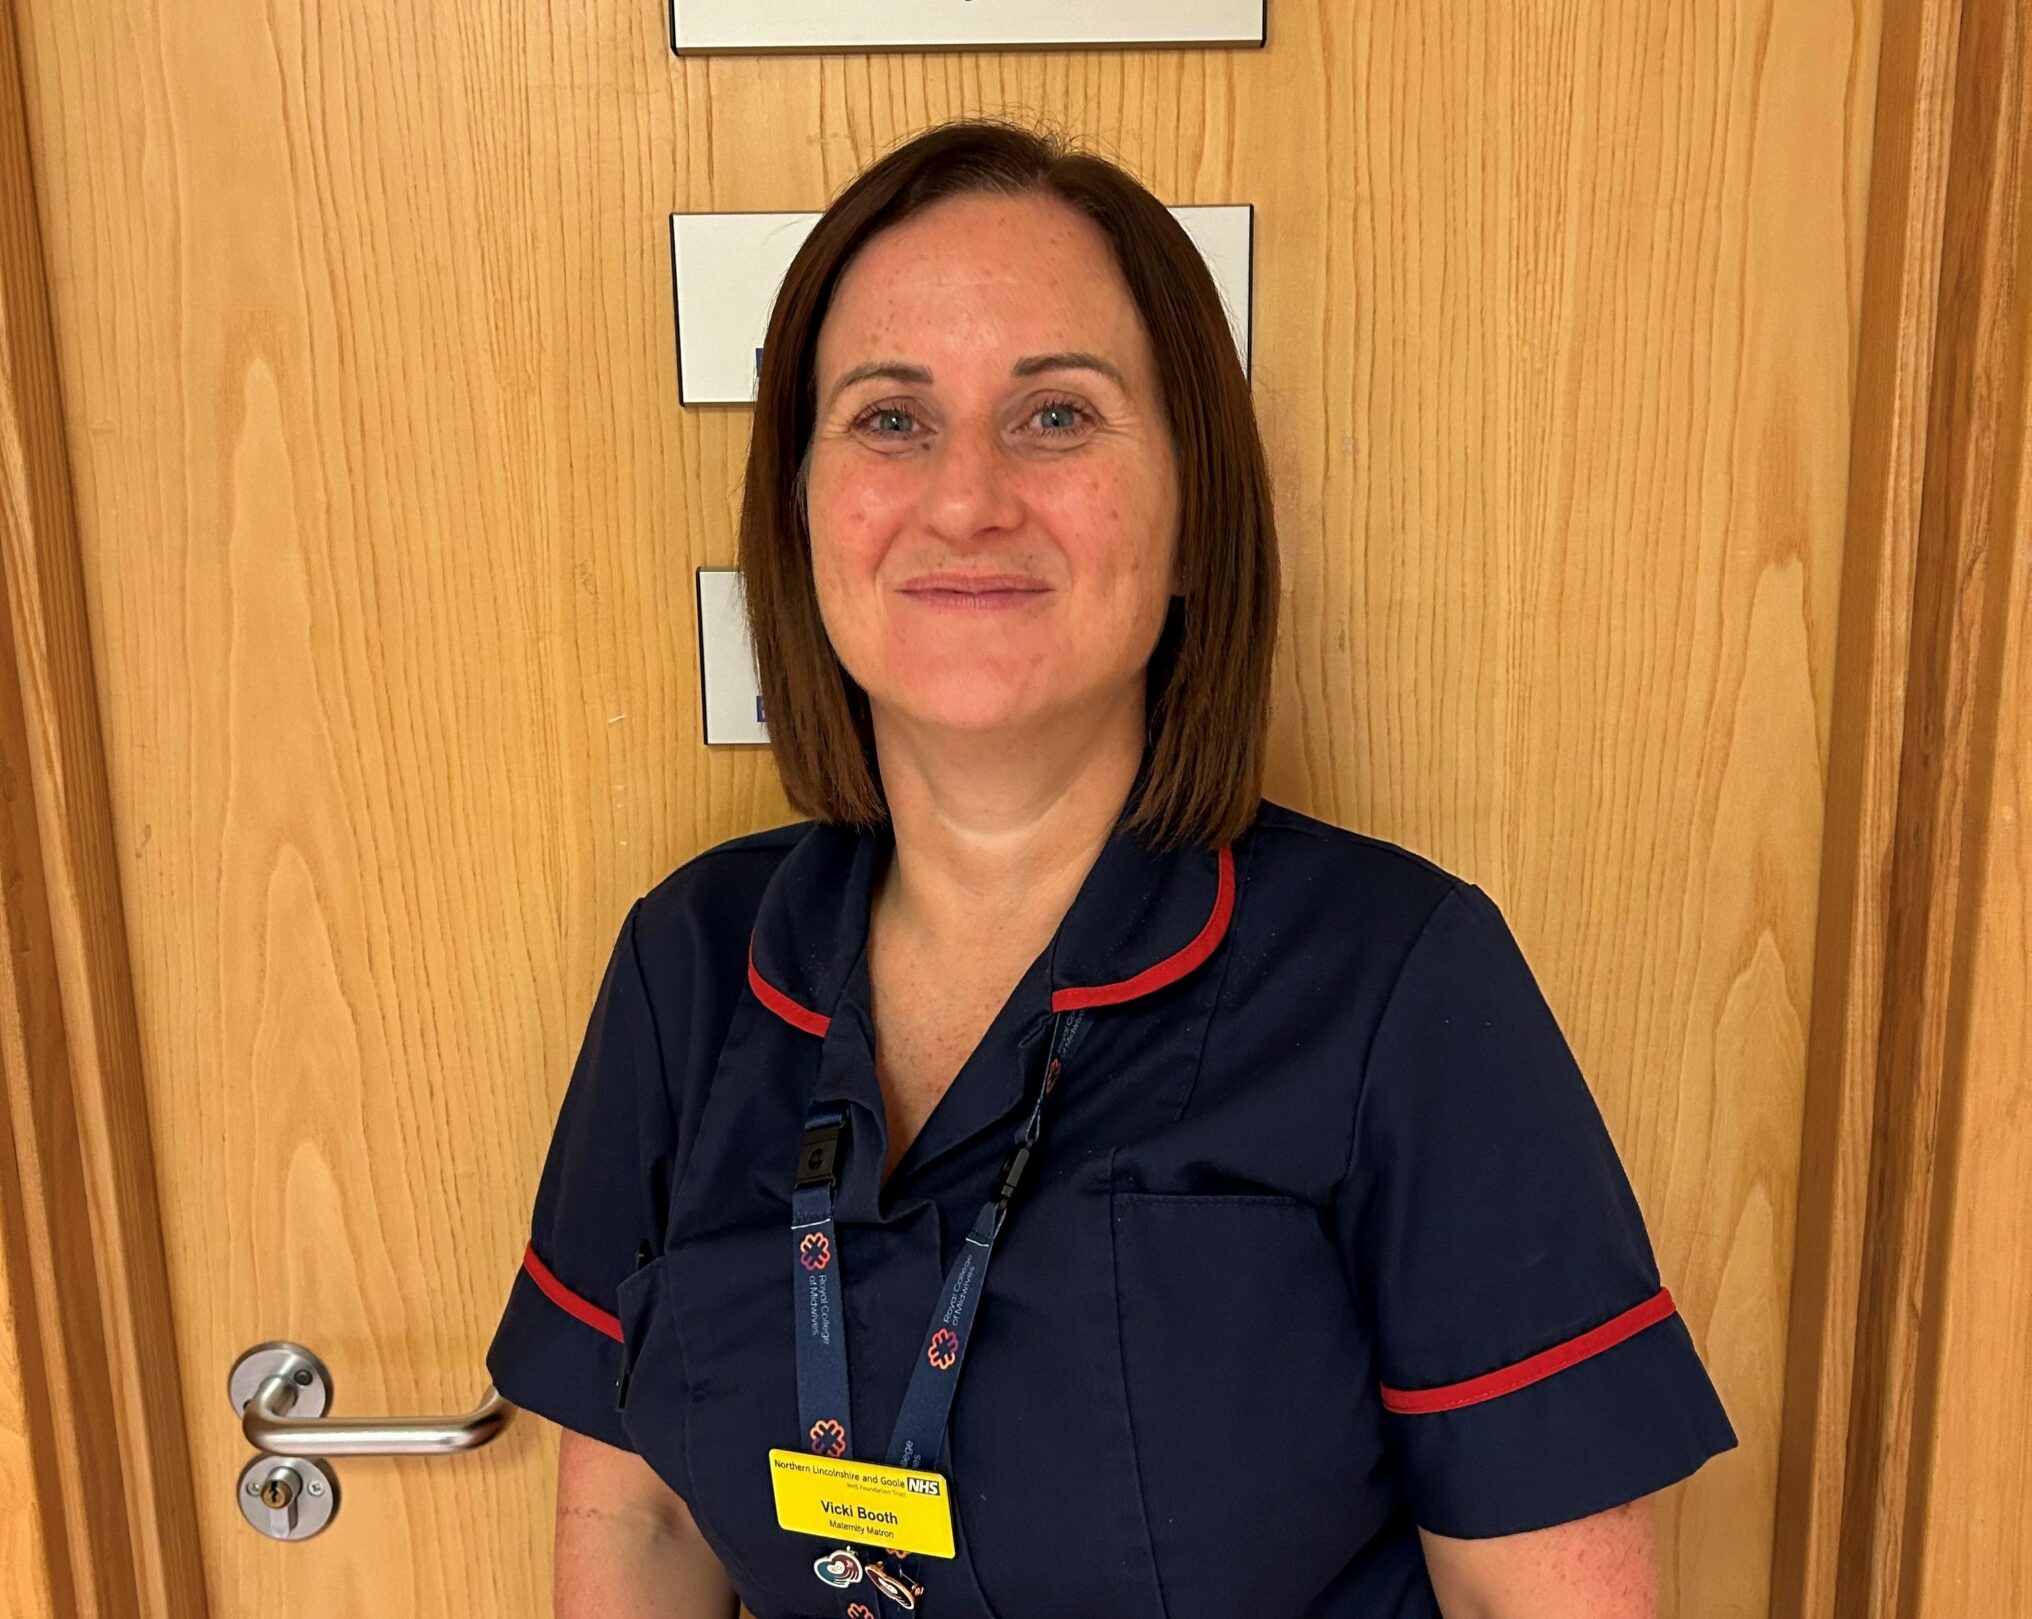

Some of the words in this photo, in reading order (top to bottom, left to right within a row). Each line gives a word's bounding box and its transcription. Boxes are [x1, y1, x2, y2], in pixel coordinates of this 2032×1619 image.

[809, 1275, 817, 1285] of
[819, 1275, 828, 1304] Royal
[809, 1287, 819, 1335] Midwives
[943, 1293, 957, 1323] Royal
[952, 1315, 960, 1326] of
[821, 1305, 830, 1345] College
[774, 1459, 811, 1472] Northern
[812, 1465, 860, 1481] Lincolnshire
[862, 1474, 878, 1484] and
[880, 1477, 905, 1488] Goole
[908, 1478, 939, 1495] NHS
[820, 1500, 854, 1517] Vicki
[857, 1506, 899, 1525] Booth
[829, 1519, 865, 1535] Maternity
[866, 1525, 895, 1539] Matron
